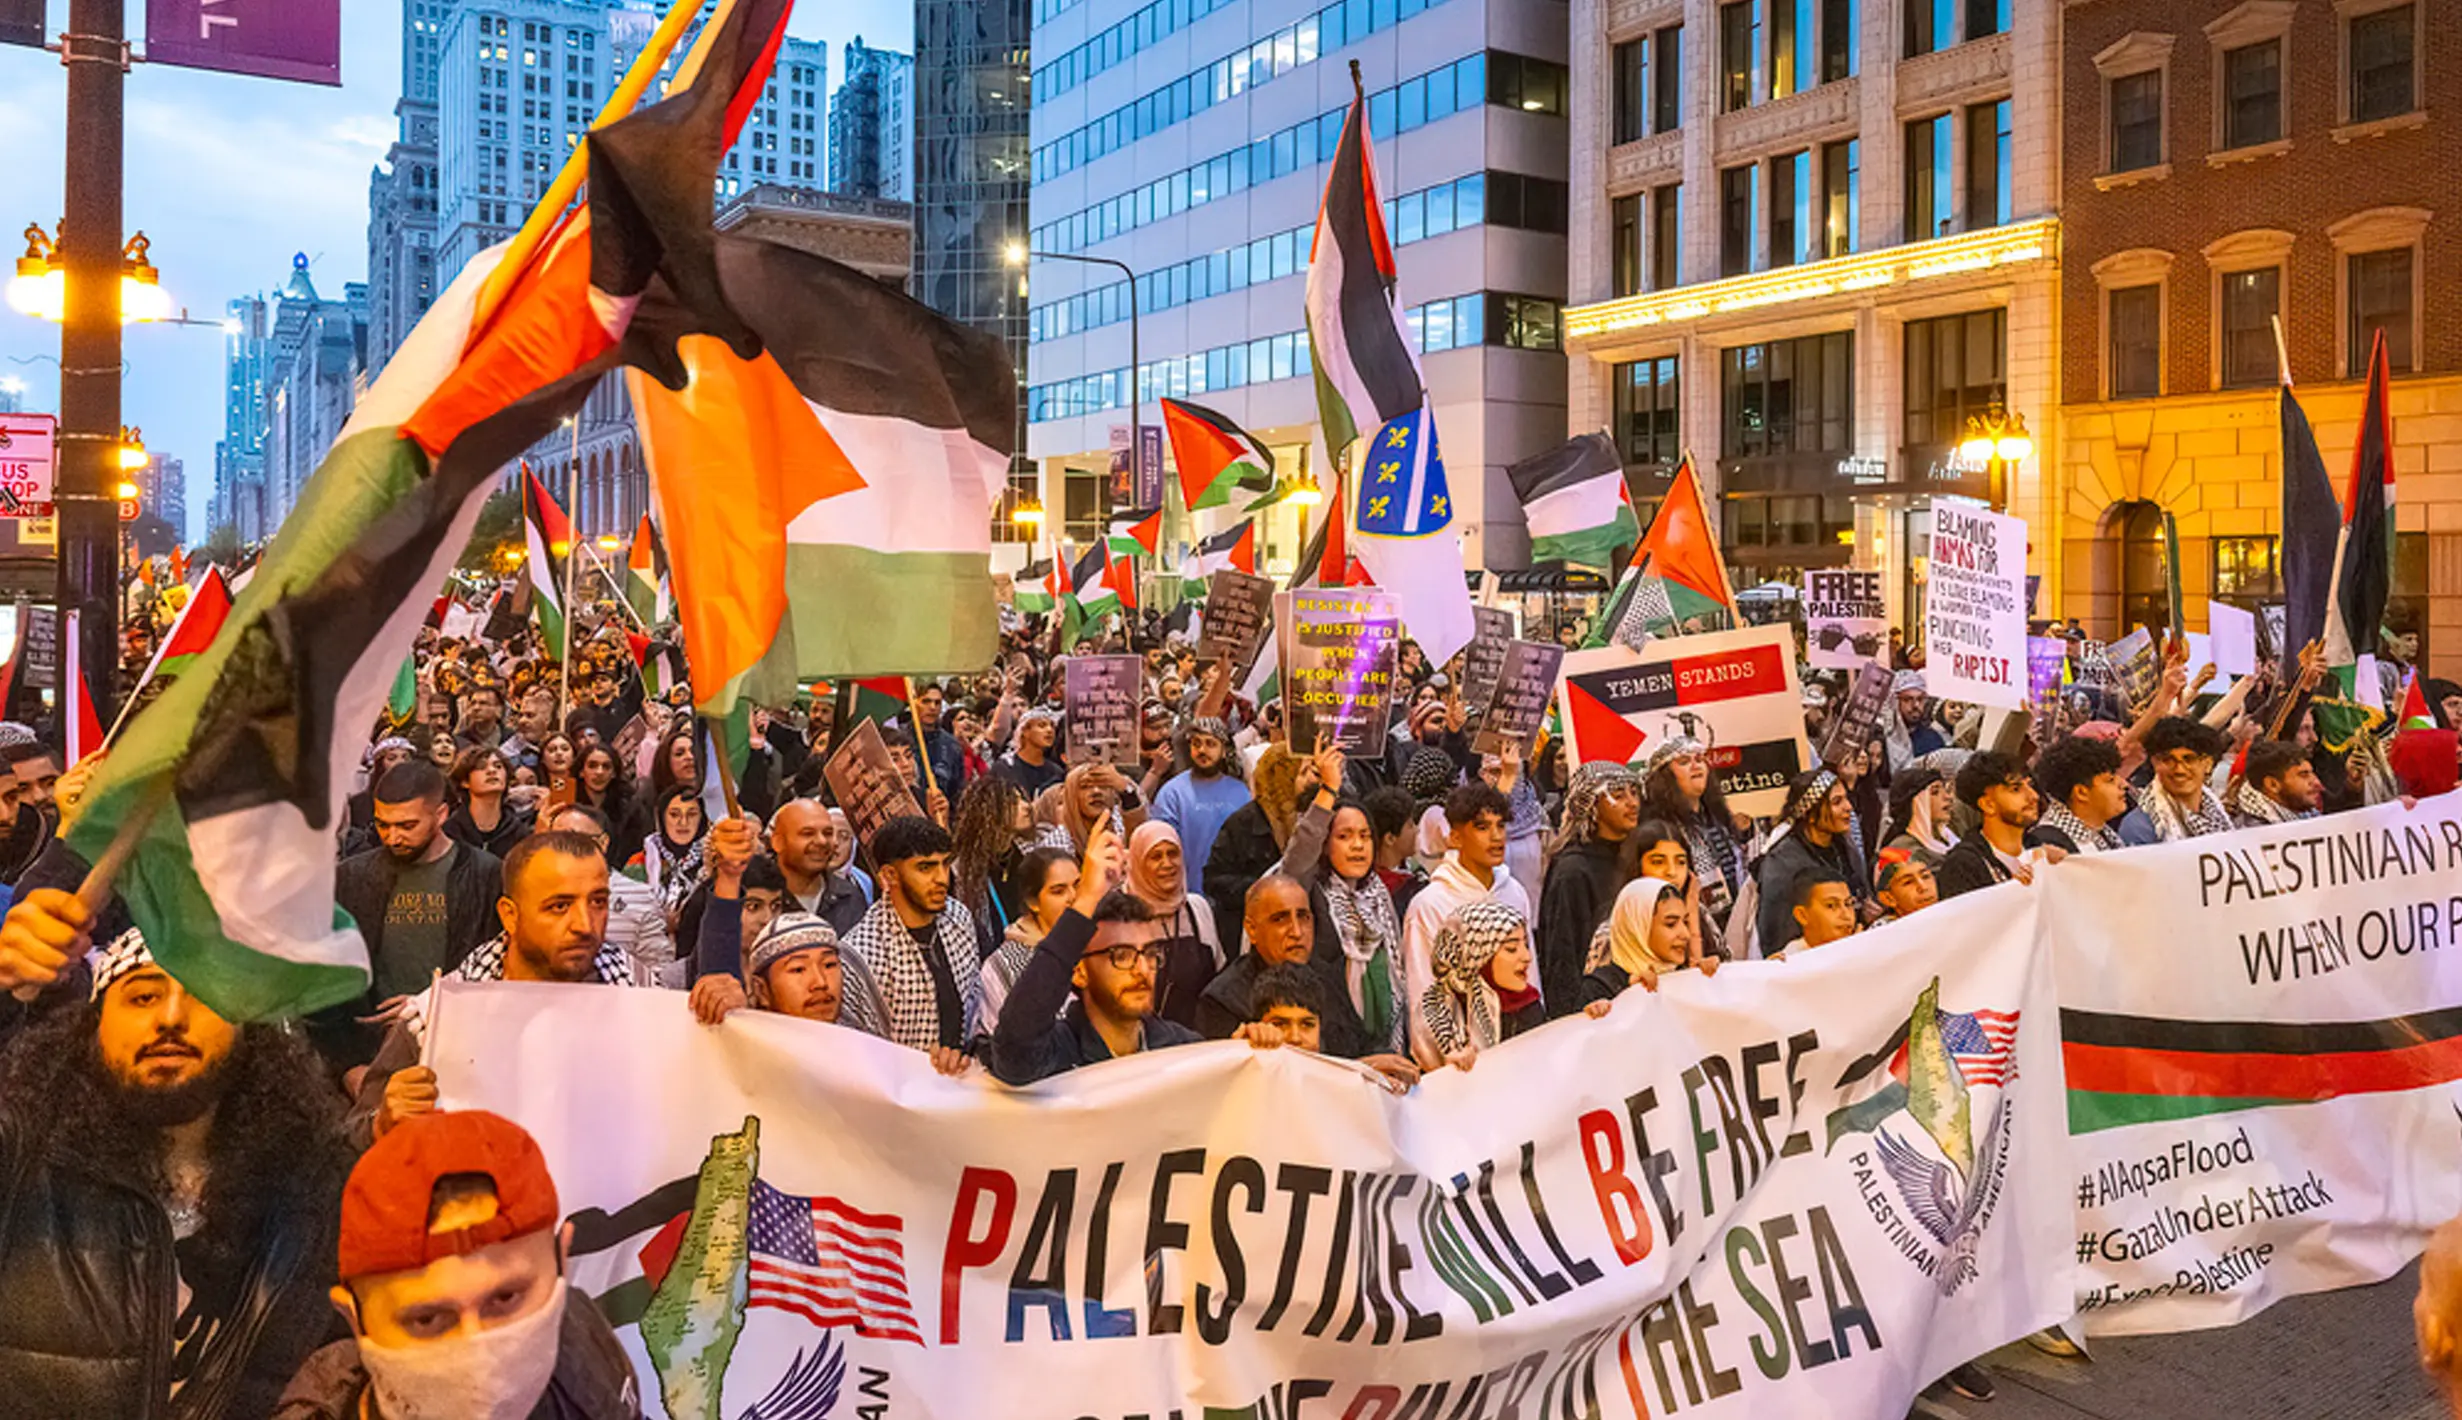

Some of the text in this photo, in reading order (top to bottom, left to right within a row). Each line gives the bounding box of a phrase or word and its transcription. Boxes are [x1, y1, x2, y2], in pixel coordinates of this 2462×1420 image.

[1937, 508, 1996, 549] BLAMING
[1978, 547, 1999, 576] FOR
[1809, 602, 1885, 618] PALESTINE
[1811, 573, 1880, 601] FREE
[1605, 661, 1756, 700] YEMEN STANDS
[2199, 824, 2437, 908] PALESTINIAN
[2239, 915, 2351, 986] WHEN
[2357, 902, 2441, 962] OUR
[940, 1147, 1444, 1346] PALESTINE
[1578, 1086, 1685, 1268] BE
[1681, 1029, 1819, 1217] FREE
[2077, 1126, 2255, 1209] #AlAqsaFlood
[1850, 1151, 1938, 1278] PALESTINIAN
[2076, 1169, 2335, 1264] #GazaUnderAttack
[1724, 1204, 1883, 1381] SEA
